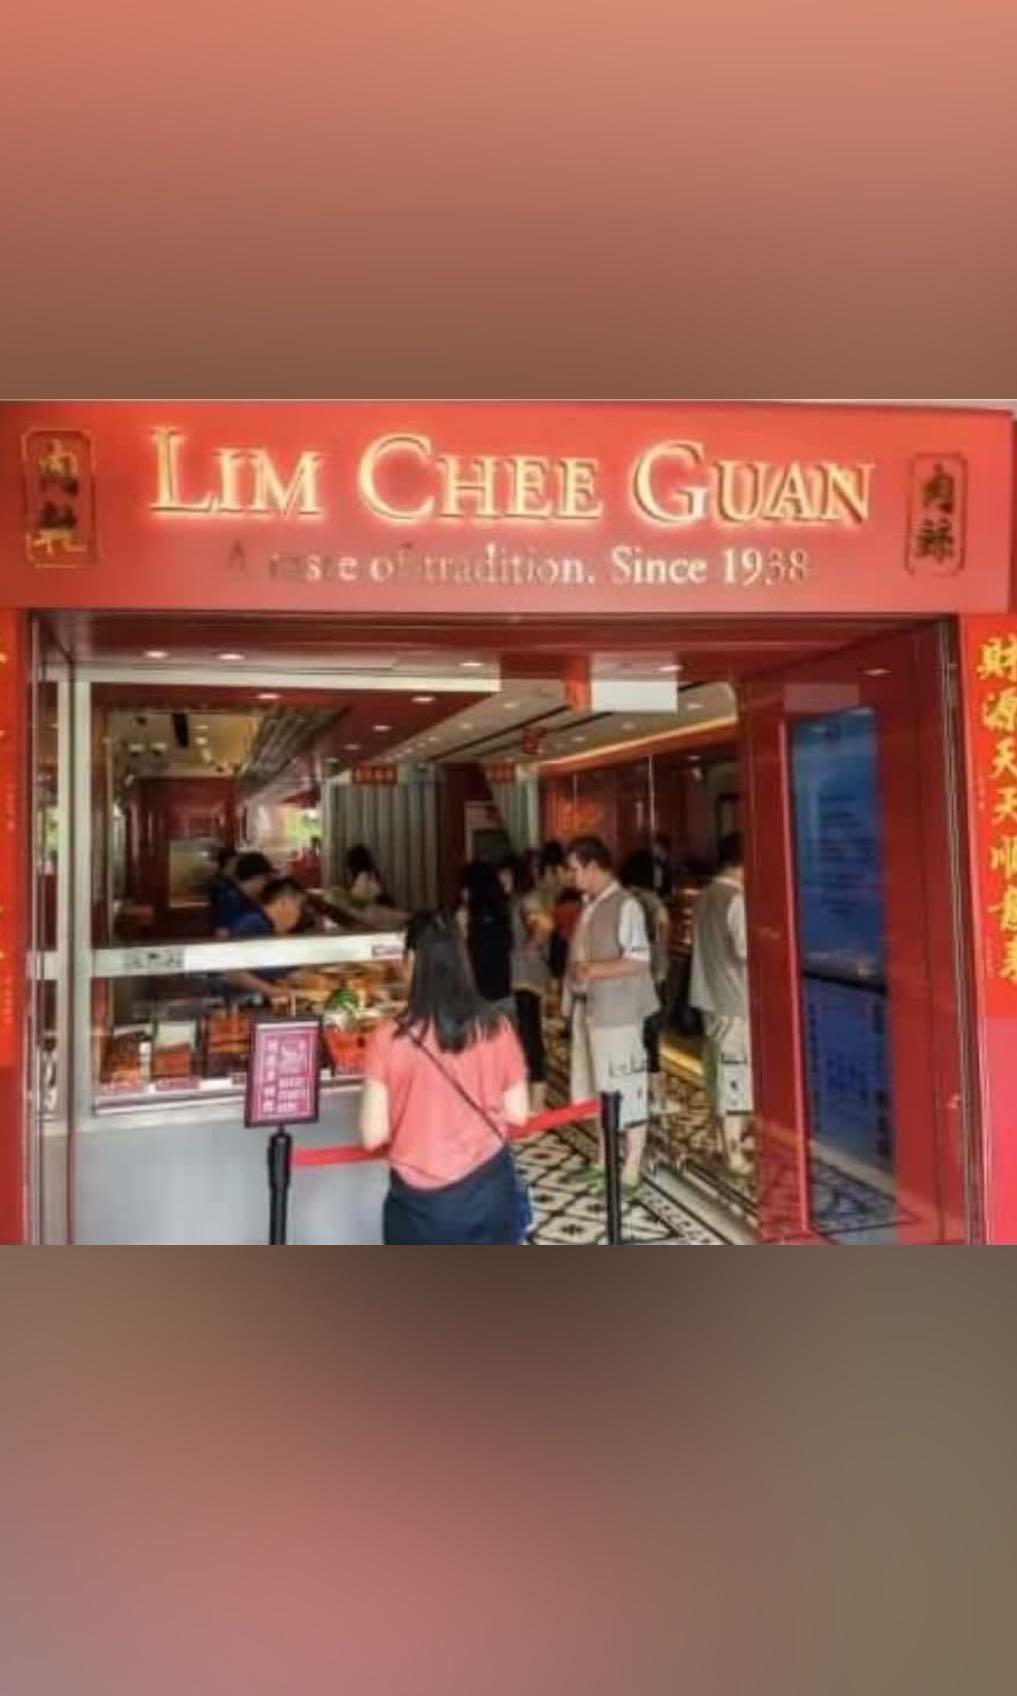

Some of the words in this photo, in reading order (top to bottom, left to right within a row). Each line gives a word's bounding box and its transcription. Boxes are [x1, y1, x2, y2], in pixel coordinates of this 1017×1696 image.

[150, 427, 323, 517] LIM
[357, 433, 601, 521] CHEE
[632, 439, 876, 526] GUAN
[422, 542, 595, 584] tradition.
[611, 545, 708, 585] Since
[722, 547, 808, 586] 1938
